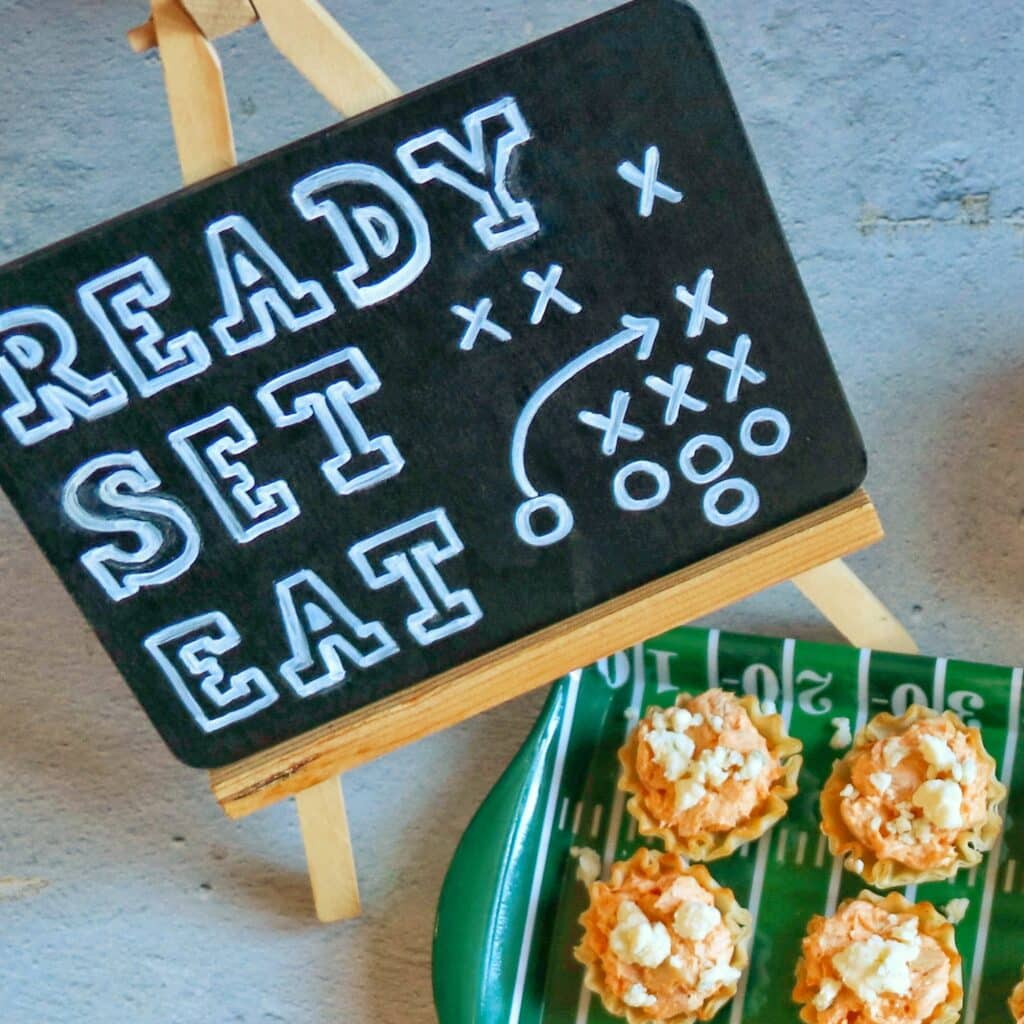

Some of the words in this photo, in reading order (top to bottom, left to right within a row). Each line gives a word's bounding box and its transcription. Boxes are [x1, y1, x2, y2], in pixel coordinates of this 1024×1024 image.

[0, 97, 541, 446] READY
[62, 346, 405, 601] SET
[143, 507, 485, 734] EAT
